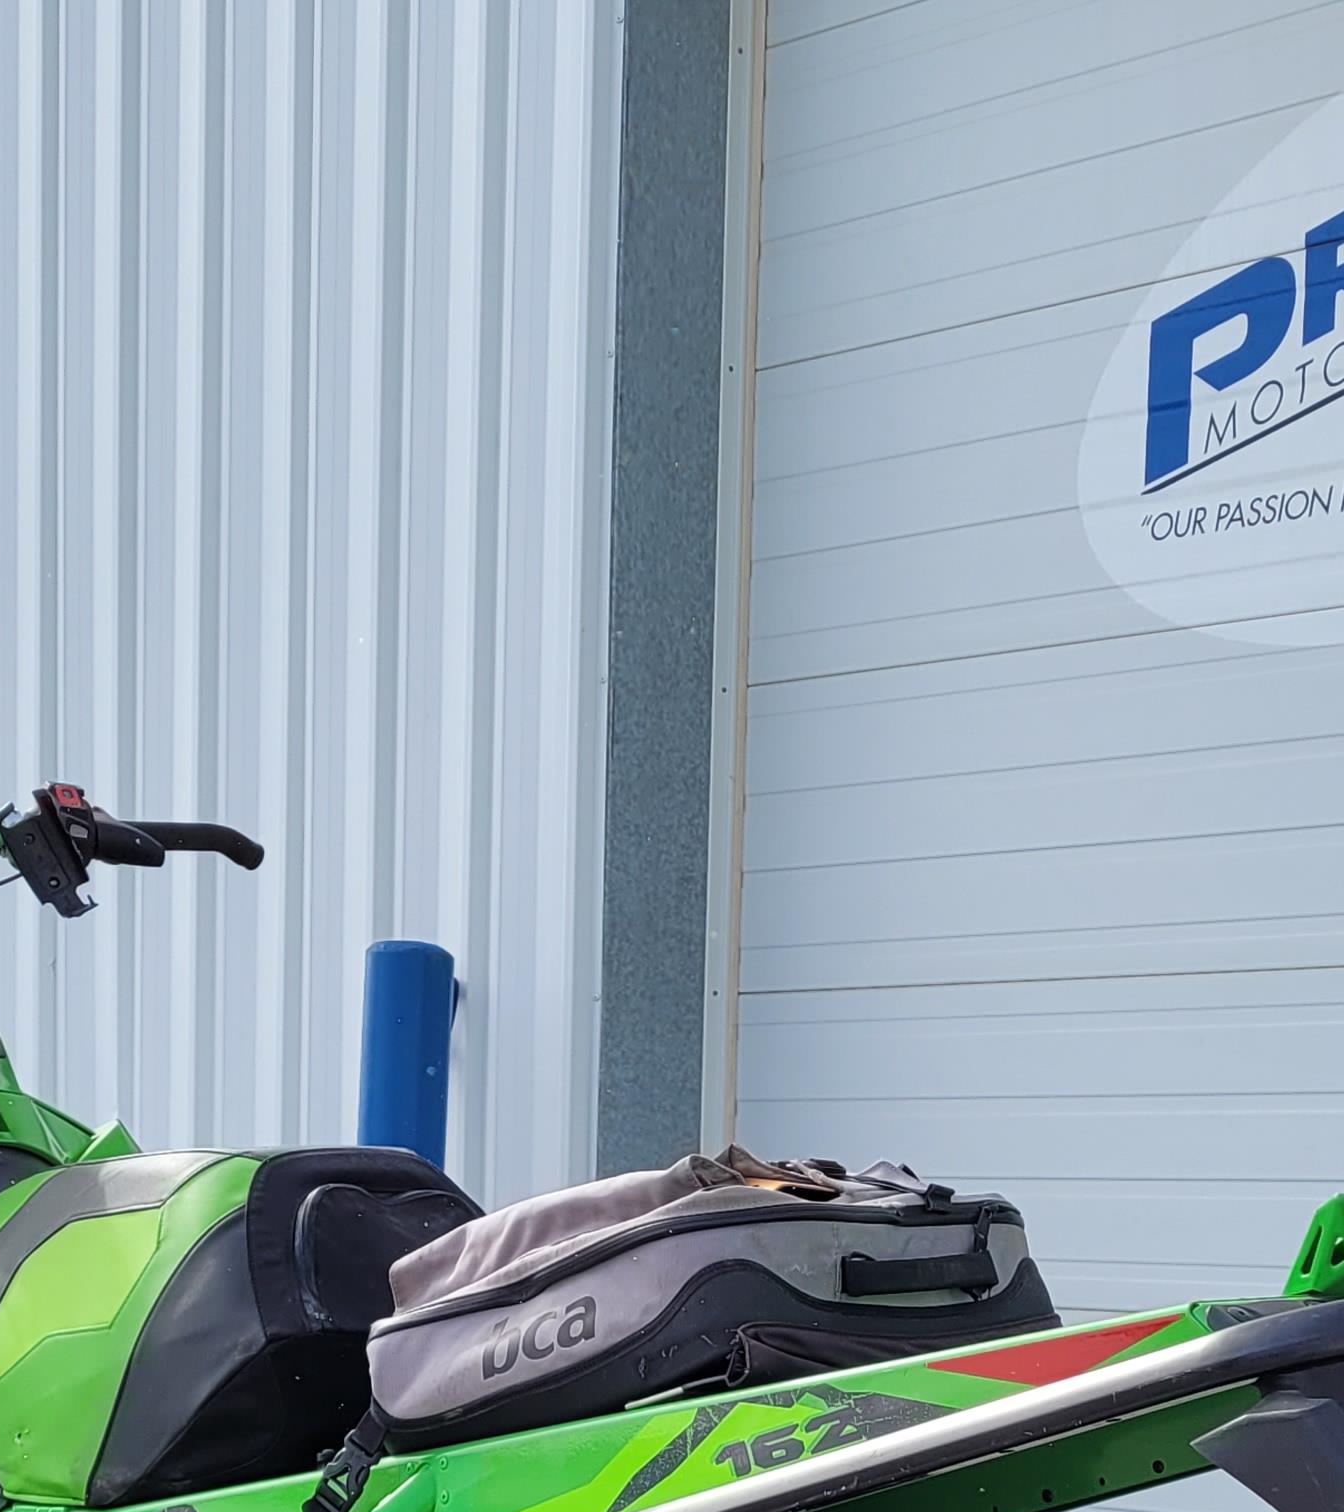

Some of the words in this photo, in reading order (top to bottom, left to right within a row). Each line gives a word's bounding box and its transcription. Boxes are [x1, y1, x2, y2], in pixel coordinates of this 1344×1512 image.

[1214, 485, 1334, 533] PASSION
[481, 1295, 597, 1381] bca
[712, 1404, 868, 1478] 162
